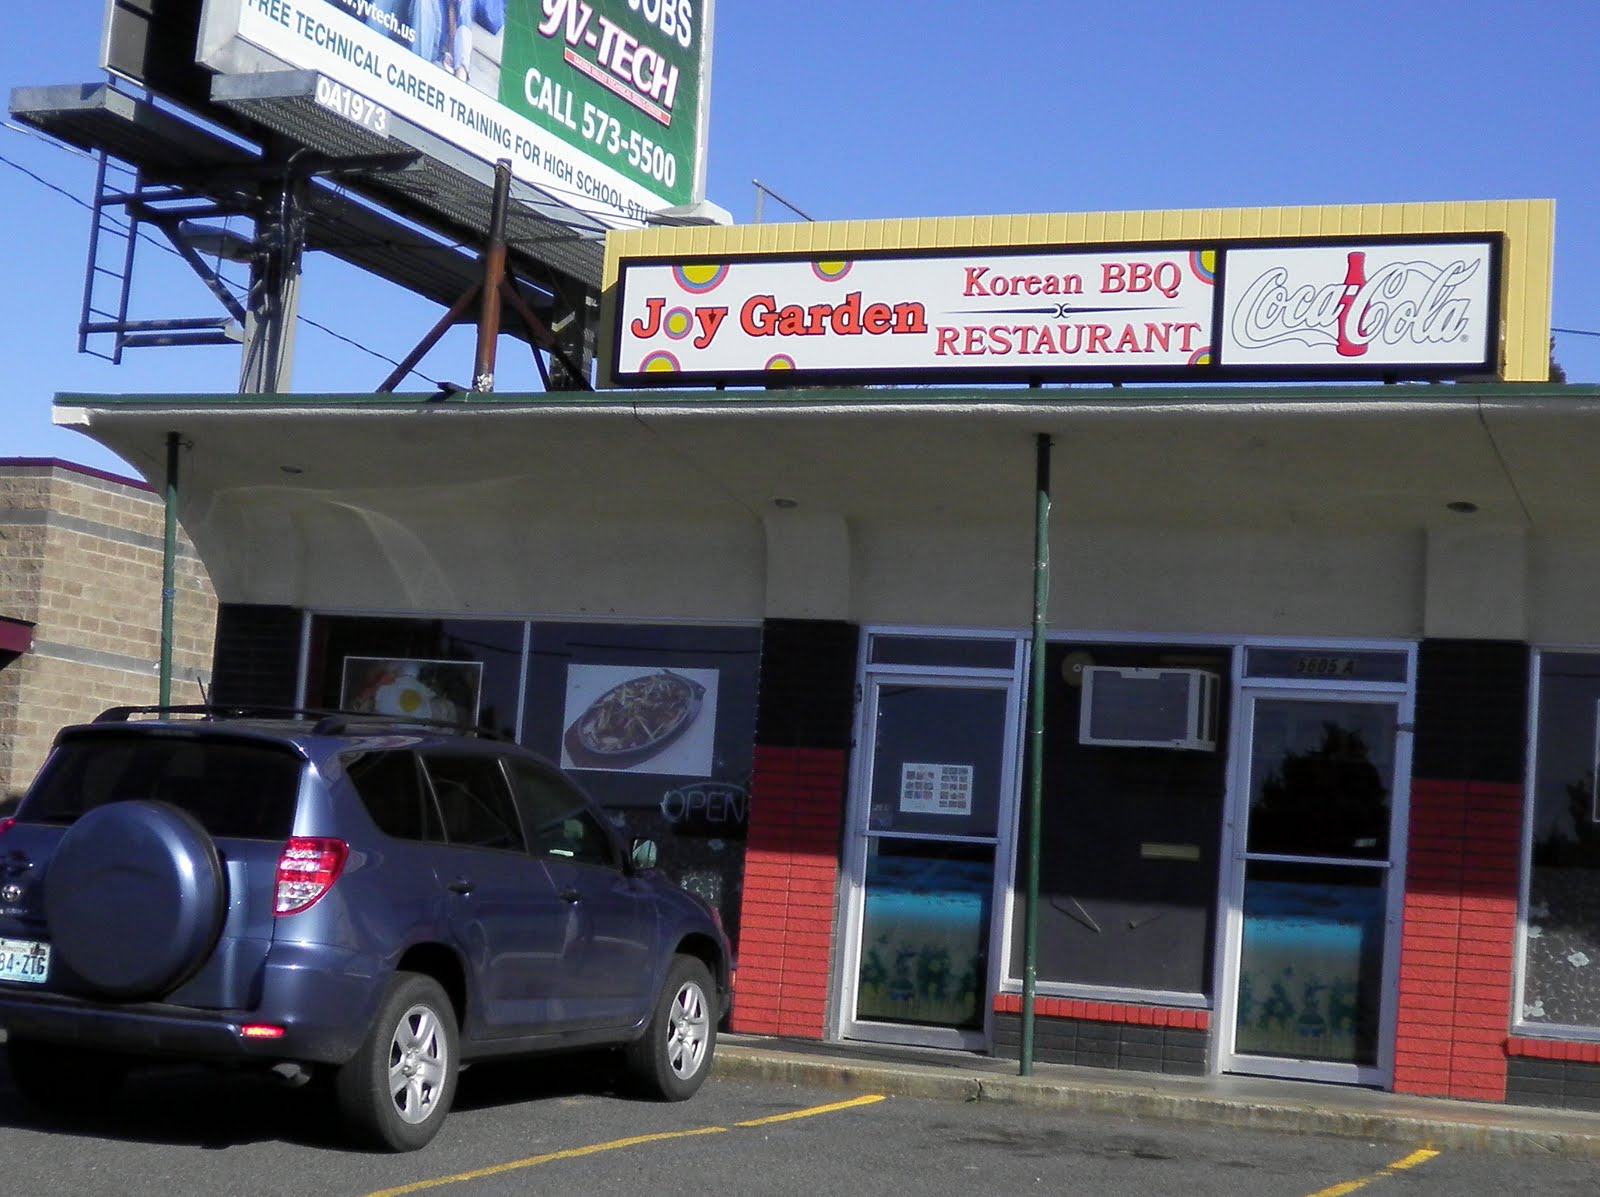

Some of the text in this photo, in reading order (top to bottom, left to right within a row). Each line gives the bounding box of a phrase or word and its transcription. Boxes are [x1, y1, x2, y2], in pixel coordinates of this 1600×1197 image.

[342, 0, 416, 42] .yvtech.us
[628, 0, 692, 47] OBS
[248, 0, 650, 225] REE TECHNICAL CAREER TRAINING FOR HIGH SCHOOL STU
[524, 67, 576, 130] CALL
[581, 101, 676, 188] 573-5500
[963, 261, 1182, 299] Korean BBQ
[631, 291, 928, 350] Joy Garden
[934, 322, 1202, 356] RESTAURANT
[662, 790, 746, 822] OPEN
